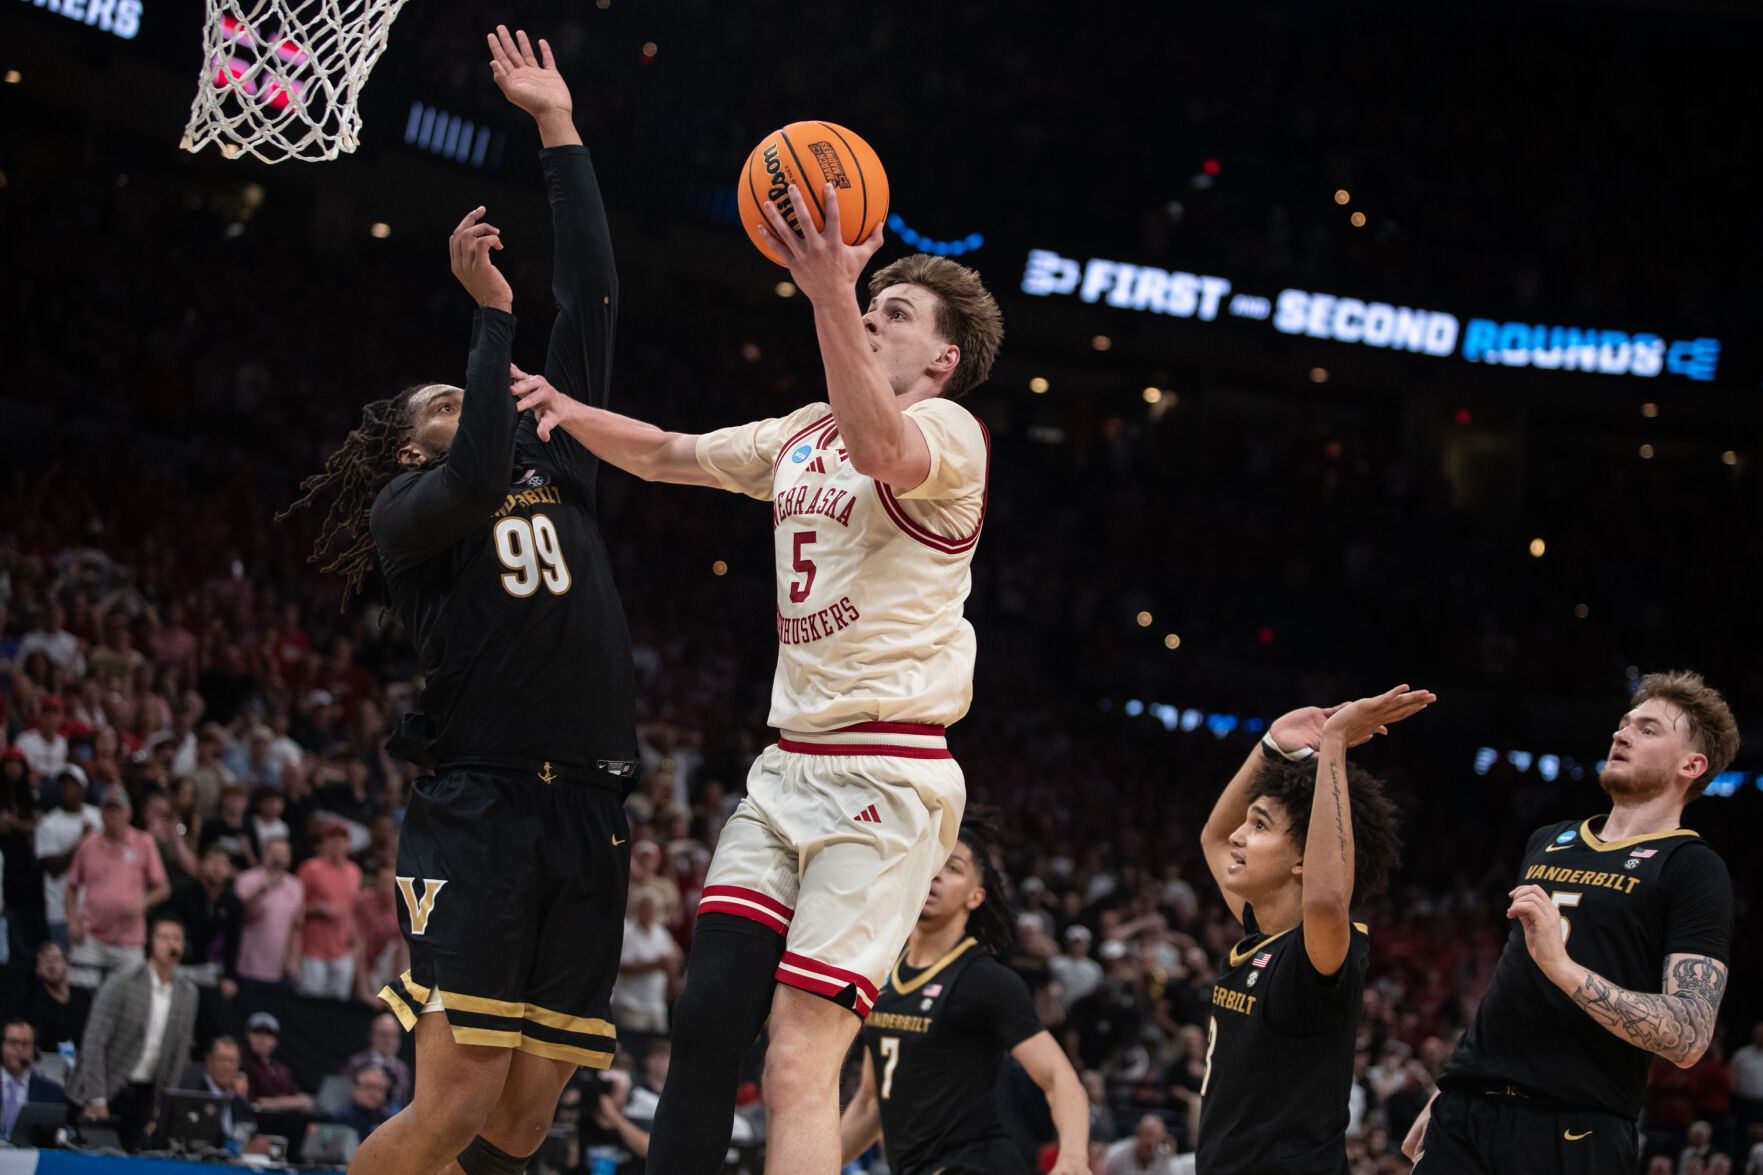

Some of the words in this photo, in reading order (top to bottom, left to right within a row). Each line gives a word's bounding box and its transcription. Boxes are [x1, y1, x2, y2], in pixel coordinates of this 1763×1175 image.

[1080, 258, 1231, 321] FIRST
[1273, 288, 1459, 357] SECOND
[1462, 318, 1666, 377] ROUNDS
[494, 514, 572, 598] 99
[790, 531, 817, 603] 5
[396, 876, 448, 935] V
[1525, 865, 1640, 894] VANDERBILT
[1551, 891, 1583, 944] 5
[881, 1036, 900, 1099] 7
